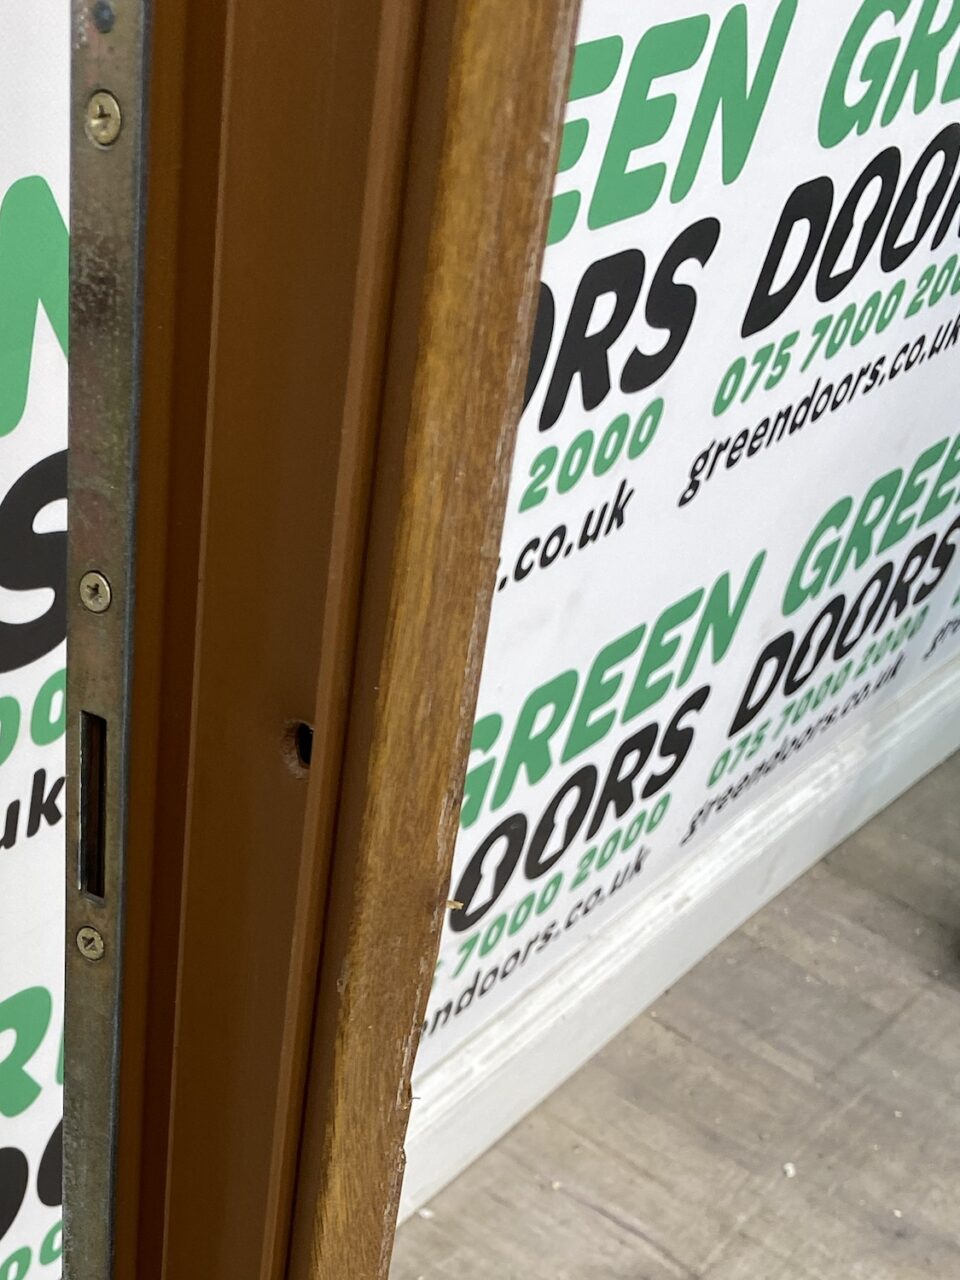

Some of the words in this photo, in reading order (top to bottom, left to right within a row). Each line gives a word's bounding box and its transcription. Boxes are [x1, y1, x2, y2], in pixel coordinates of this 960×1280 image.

[818, 0, 960, 148] GR
[712, 330, 800, 417] 075
[799, 278, 907, 373] 7000
[518, 396, 665, 514] 2000
[782, 432, 960, 617] GREE
[495, 478, 635, 592] .co.uk
[727, 512, 960, 738] DOORS
[708, 717, 772, 788] 075
[773, 660, 855, 741] 7000
[422, 844, 651, 1037] ndoors.co.uk
[451, 872, 564, 979] 7000
[571, 793, 671, 890] 2000
